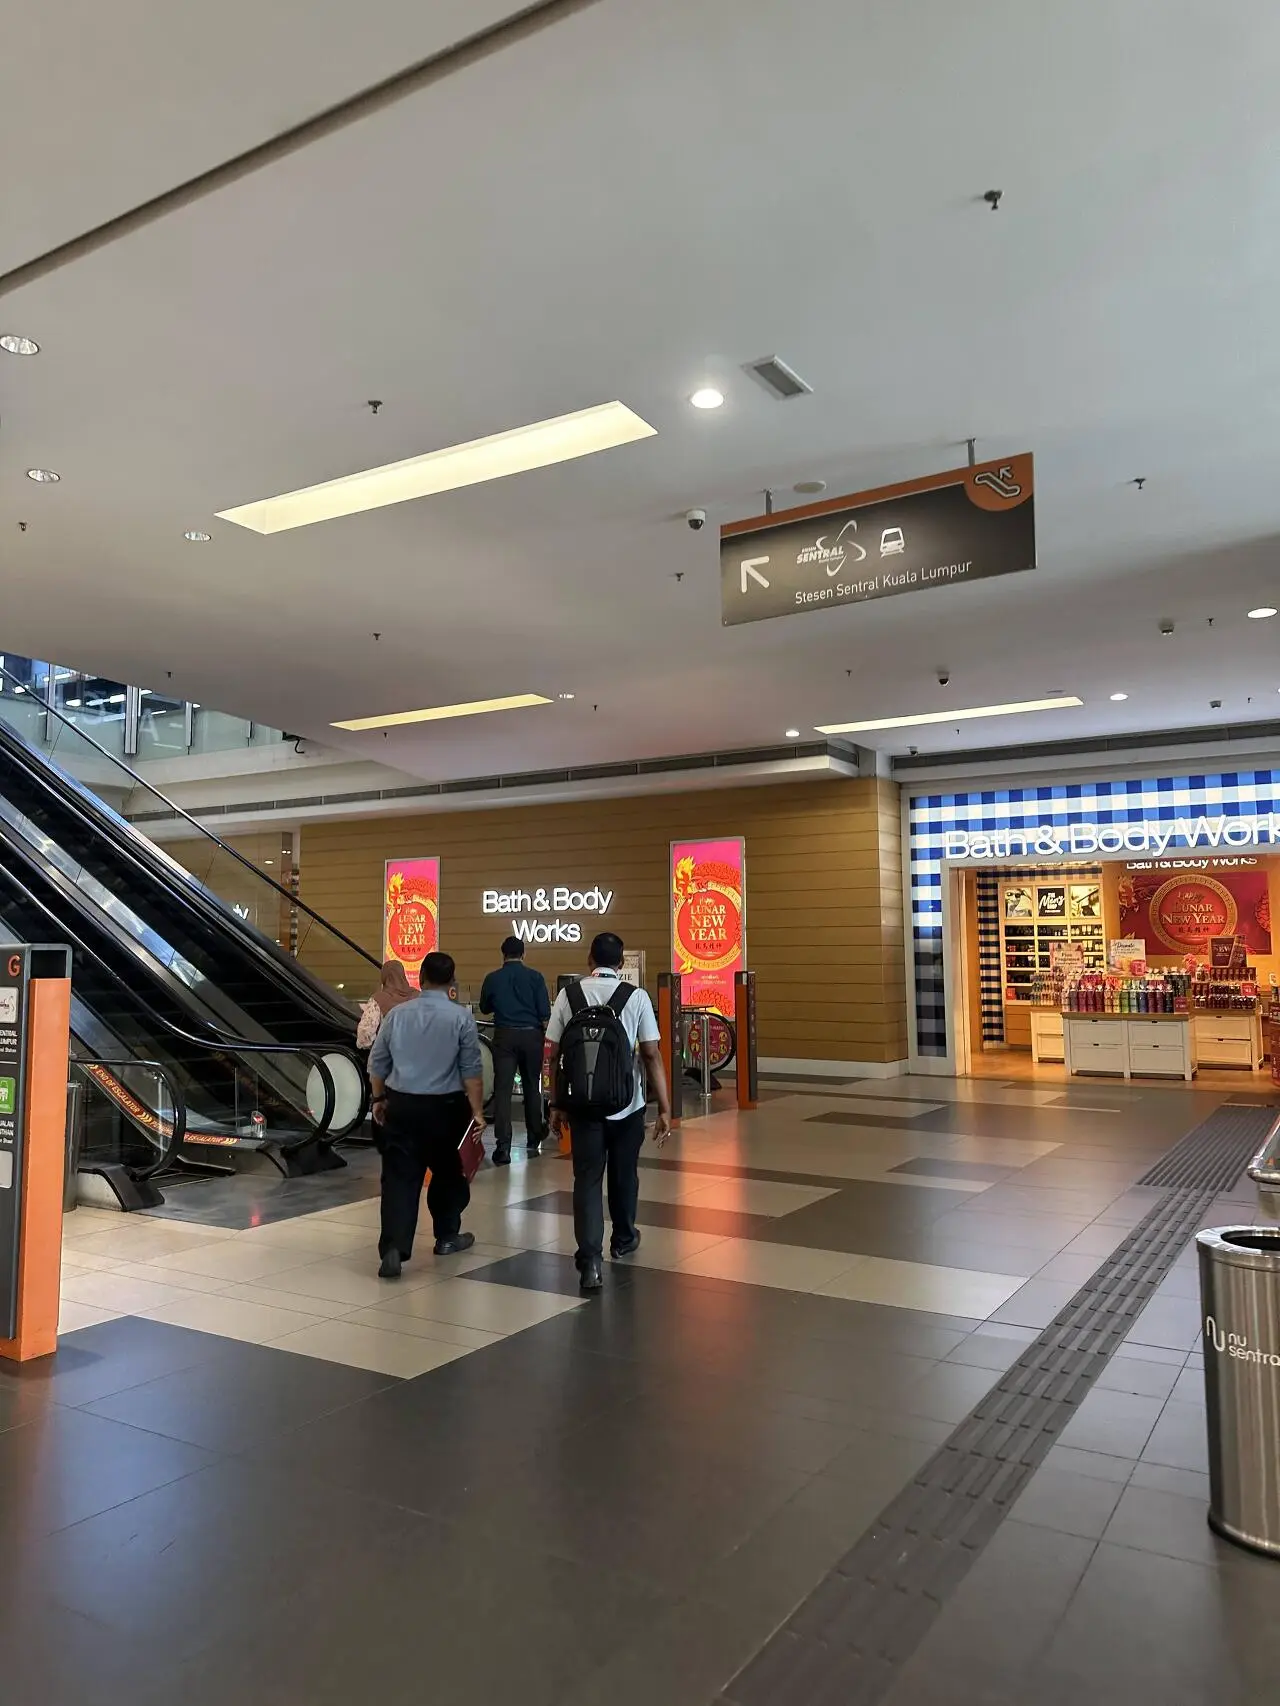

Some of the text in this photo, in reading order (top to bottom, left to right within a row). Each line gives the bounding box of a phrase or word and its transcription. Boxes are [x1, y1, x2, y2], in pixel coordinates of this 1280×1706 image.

[796, 545, 844, 564] SENTRAL
[795, 560, 972, 604] Stesen Sentral Kuala Lumpur
[944, 812, 1280, 859] Bath & Body Work
[482, 885, 613, 915] Bath & Body
[690, 904, 726, 914] LUNAR
[399, 914, 426, 923] LUNAR
[690, 914, 727, 928] NEW
[1161, 912, 1226, 924] NEW YEAR
[399, 923, 426, 935] NEW
[511, 918, 582, 943] Works
[688, 928, 728, 941] YEAR
[397, 935, 426, 946] YEAR
[8, 954, 21, 977] G
[448, 986, 457, 999] G
[96, 1069, 109, 1081] END
[112, 1085, 141, 1113] ESCALATOR
[1228, 1333, 1247, 1347] nu
[1228, 1345, 1280, 1367] sentra
